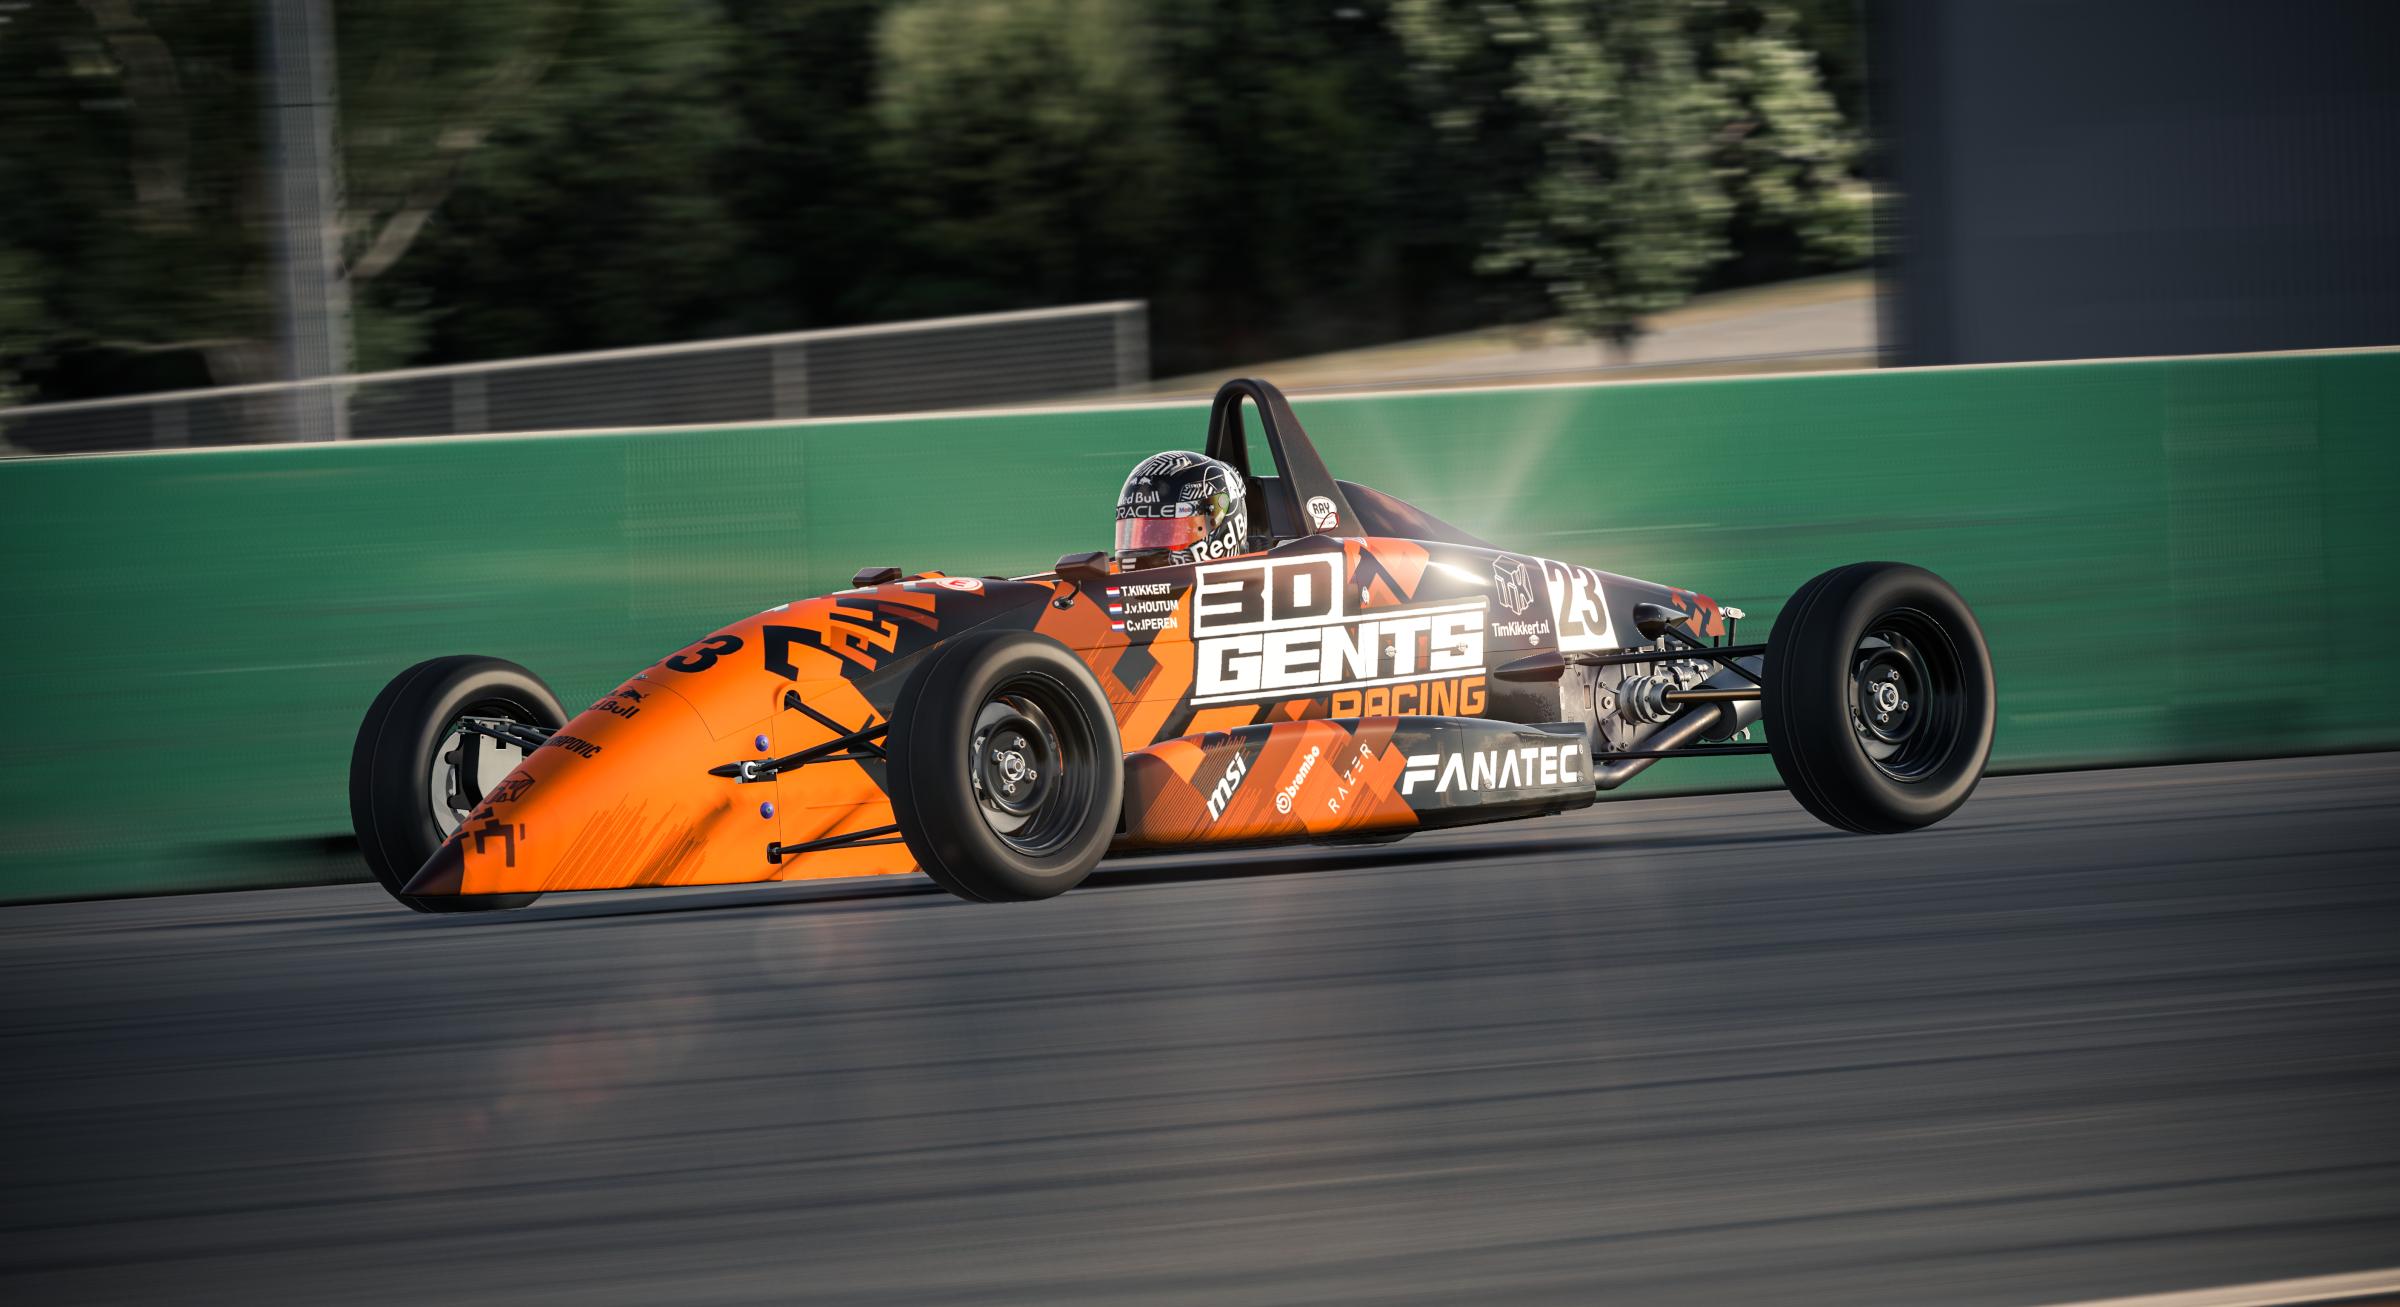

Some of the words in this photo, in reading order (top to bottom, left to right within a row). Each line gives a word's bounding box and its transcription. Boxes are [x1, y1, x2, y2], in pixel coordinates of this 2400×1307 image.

[1116, 504, 1175, 519] RACLE
[1135, 491, 1161, 504] Bull
[1312, 502, 1330, 515] RAY
[1121, 583, 1172, 597] T.KIKKERT
[1124, 599, 1179, 614] J.v.HOUTUM
[1198, 559, 1335, 630] 3D
[1545, 558, 1608, 638] 23
[1126, 617, 1178, 631] C.v.IPEREN
[1491, 619, 1550, 637] TimKikkert.nl
[1195, 610, 1486, 697] GENTS
[1331, 676, 1486, 718] RACING
[1206, 751, 1247, 821] msi
[1284, 745, 1320, 799] brembo
[1327, 741, 1372, 814] RAZER
[1401, 744, 1578, 796] FANATEC
